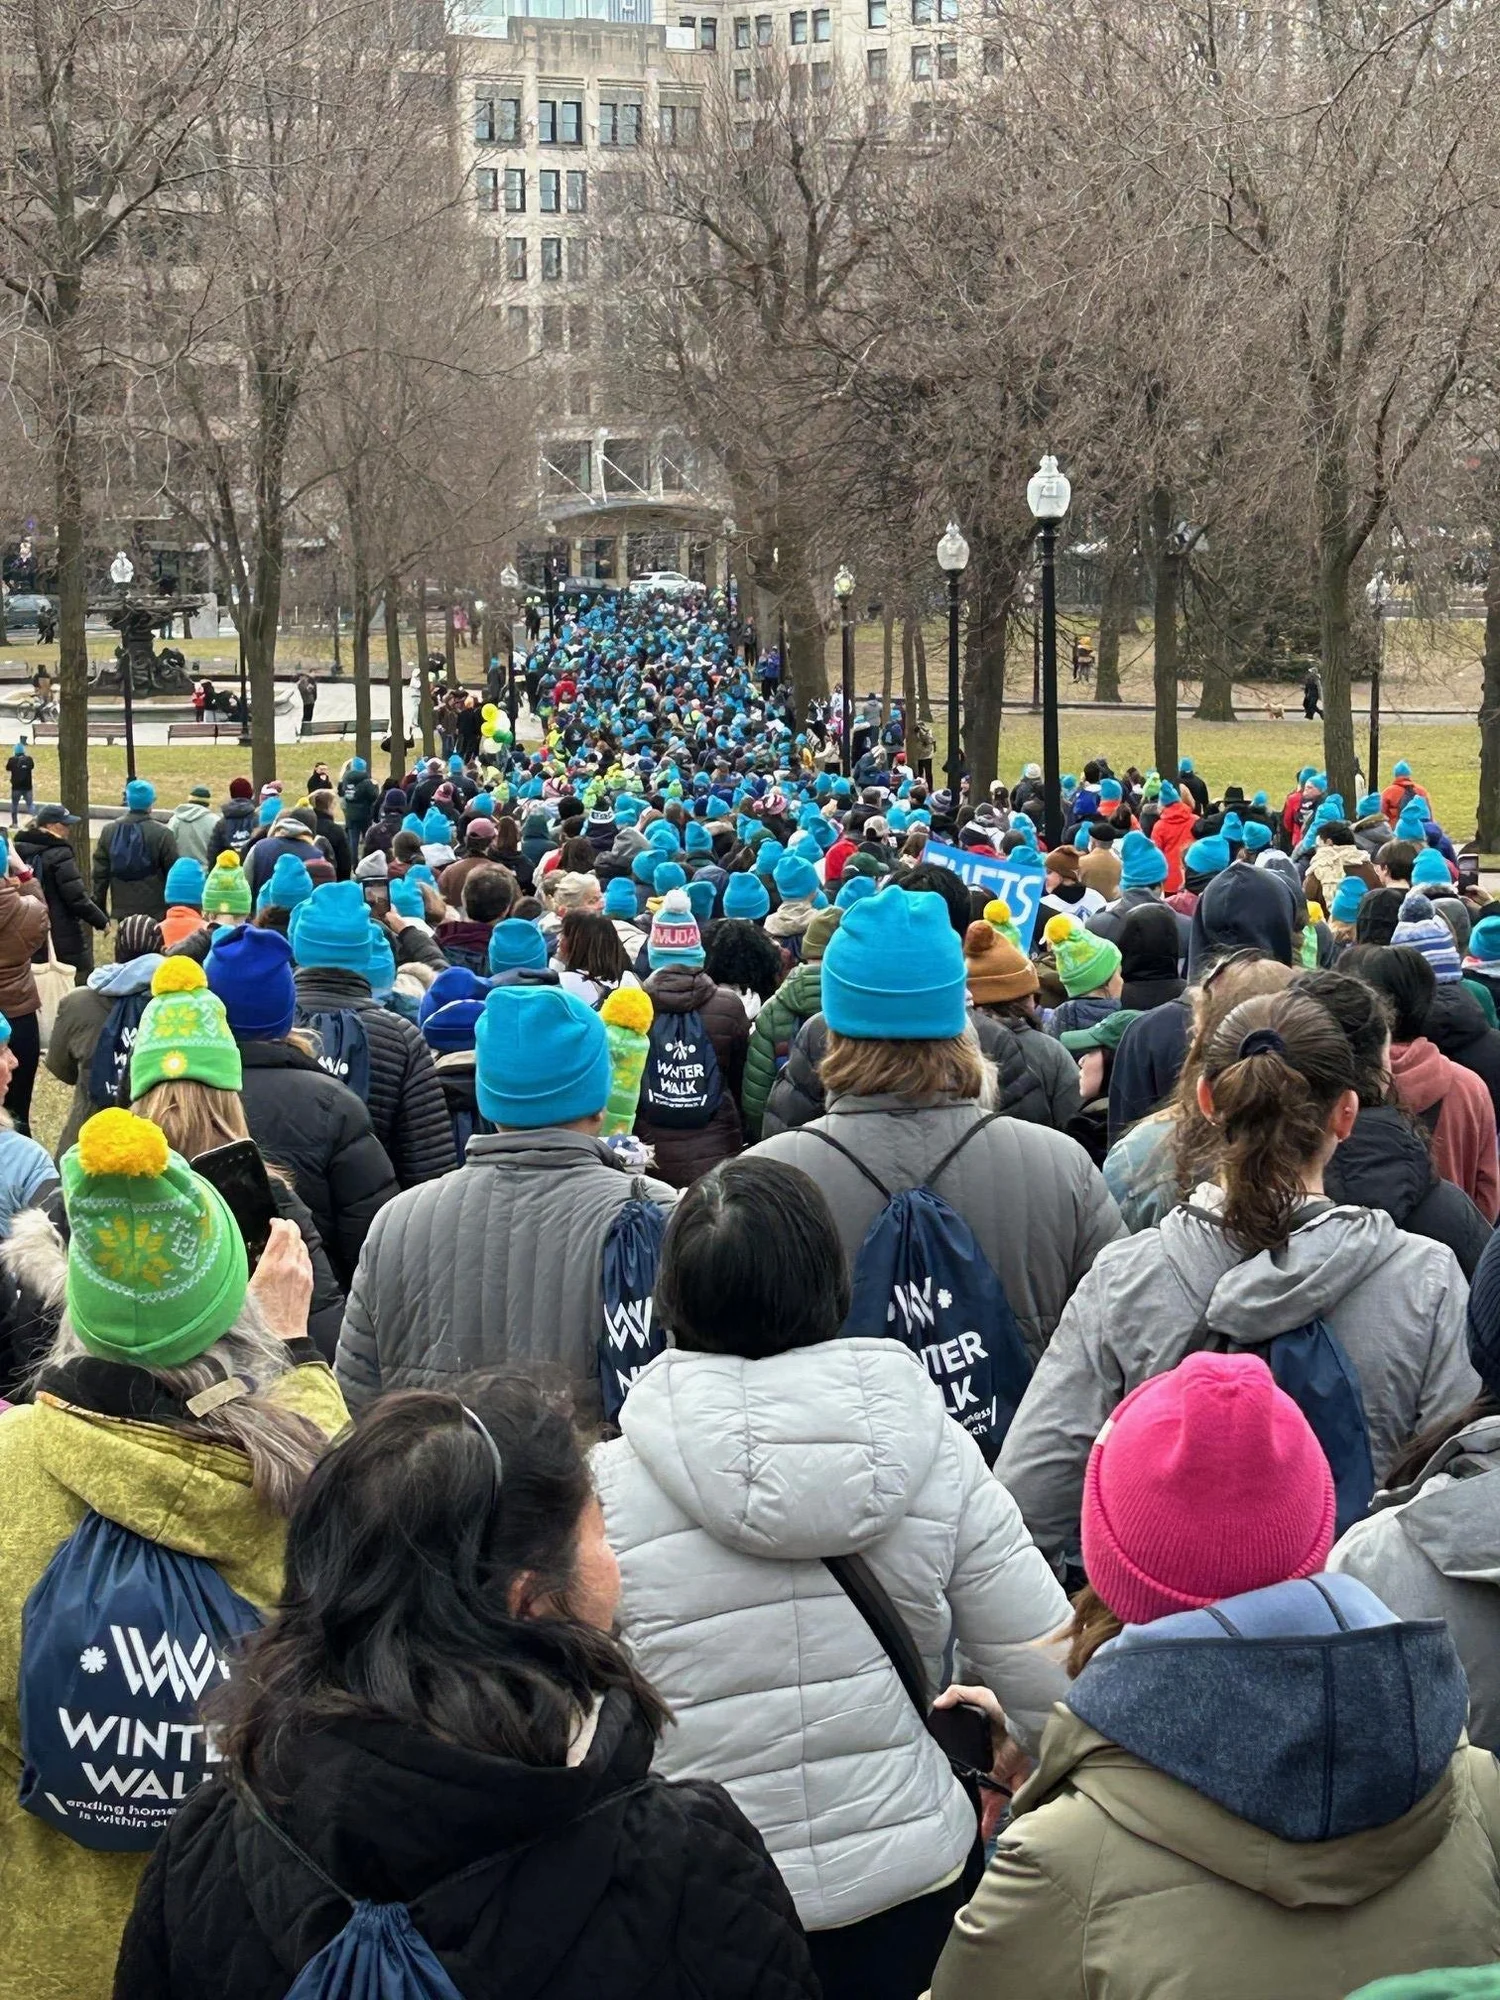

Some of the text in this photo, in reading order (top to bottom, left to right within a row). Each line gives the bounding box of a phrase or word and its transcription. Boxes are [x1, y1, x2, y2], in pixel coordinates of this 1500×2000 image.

[58, 1706, 225, 1763] WINTE
[81, 1761, 214, 1800] WAL
[95, 1813, 148, 1828] within
